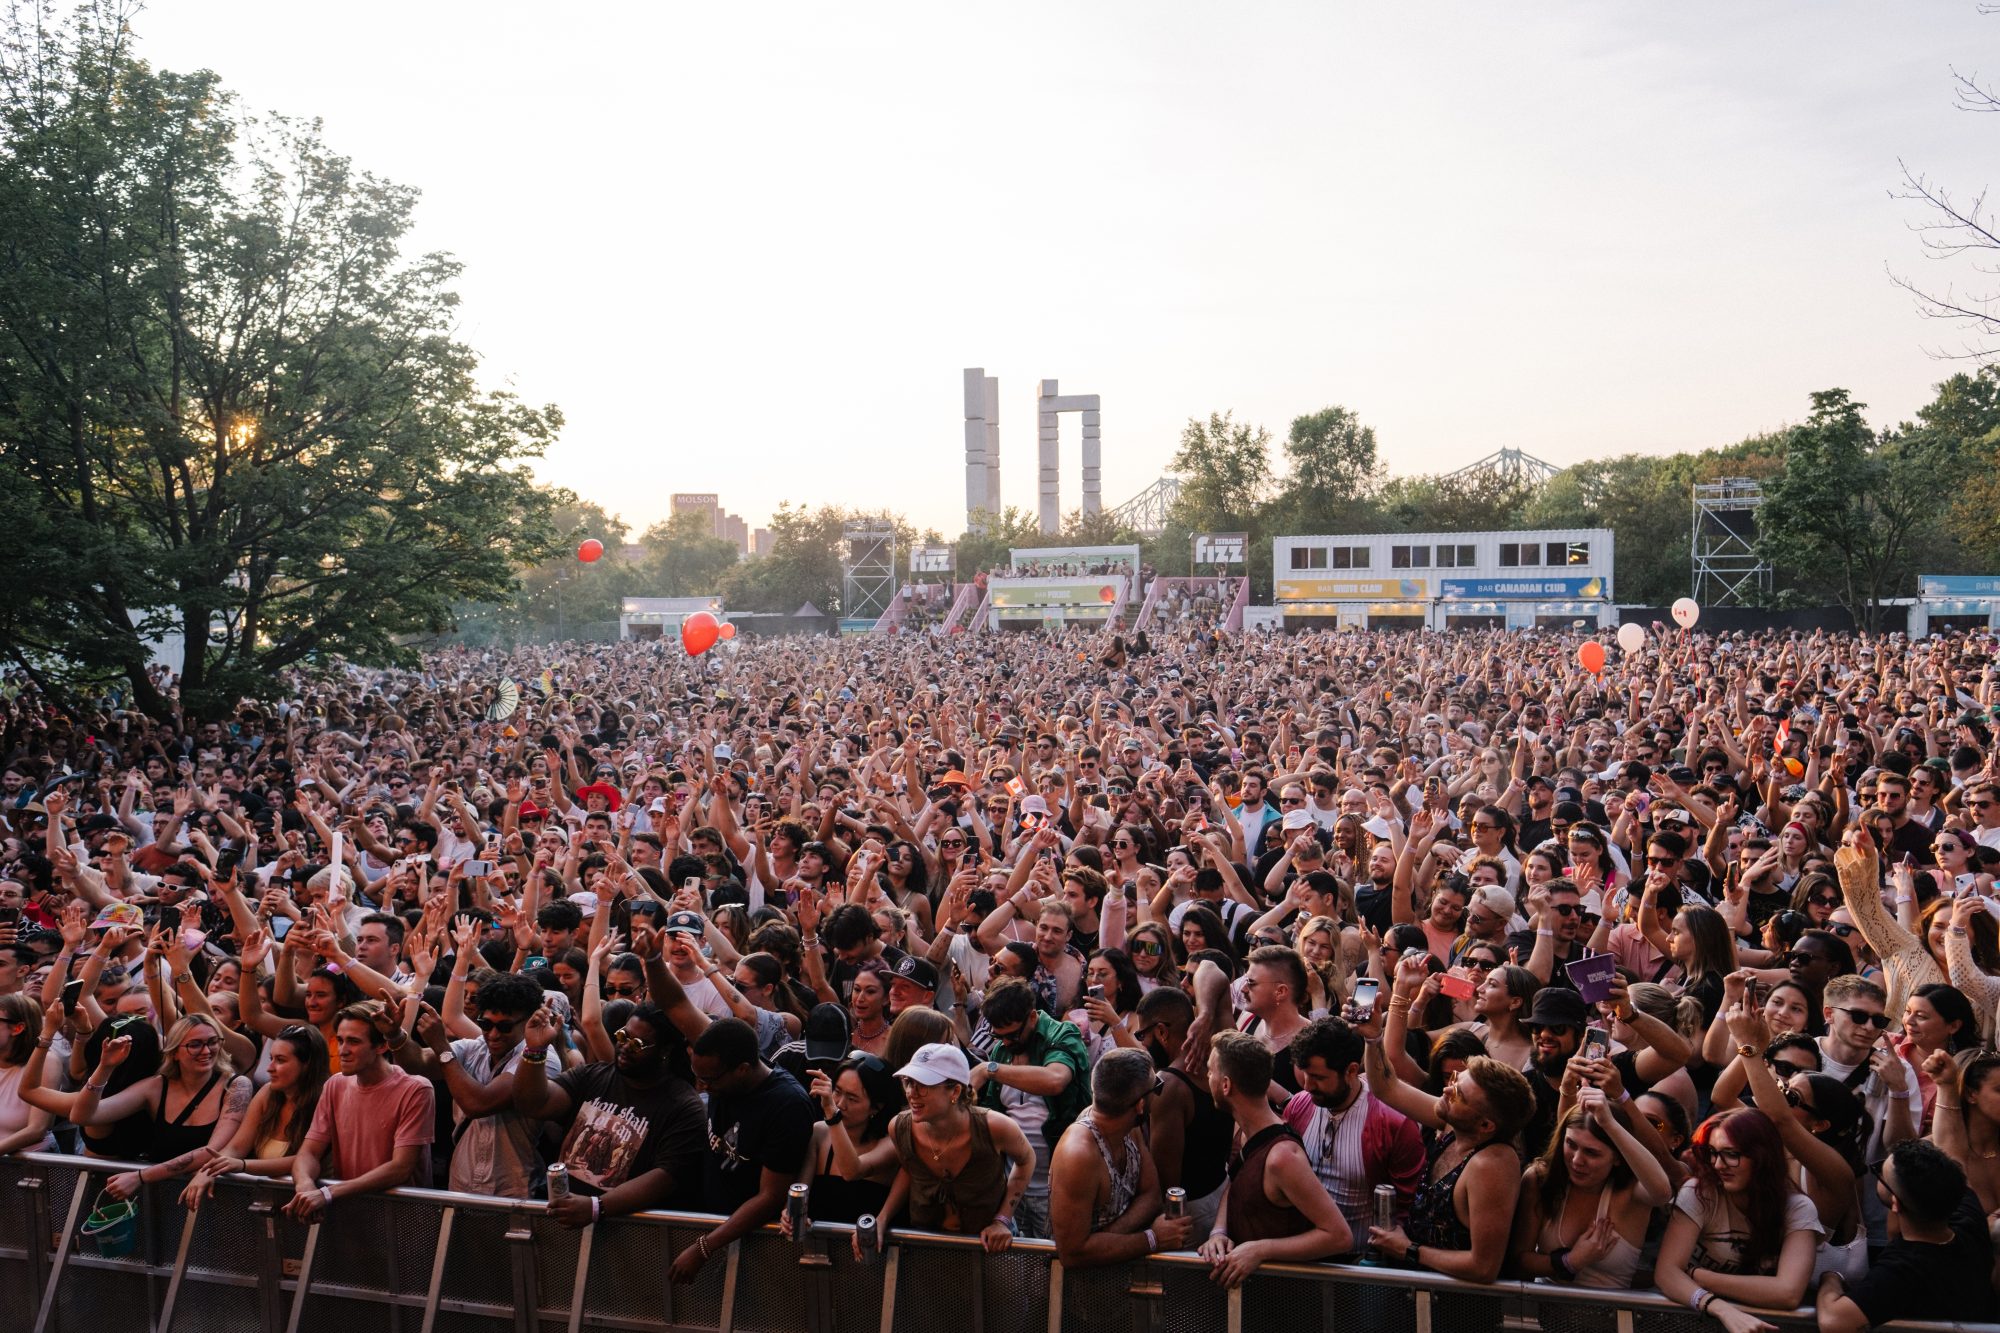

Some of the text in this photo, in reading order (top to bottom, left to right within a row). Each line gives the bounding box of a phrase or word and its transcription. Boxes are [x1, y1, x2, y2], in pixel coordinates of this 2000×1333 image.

[676, 496, 717, 504] MOLSON
[1317, 584, 1383, 593] BAR WHITE CLAW
[1477, 585, 1494, 593] BAR
[1494, 583, 1542, 593] CANADIAN
[1544, 583, 1567, 593] CLUB
[1975, 582, 1992, 591] BAR
[618, 1106, 650, 1138] shall
[611, 1121, 632, 1143] cap
